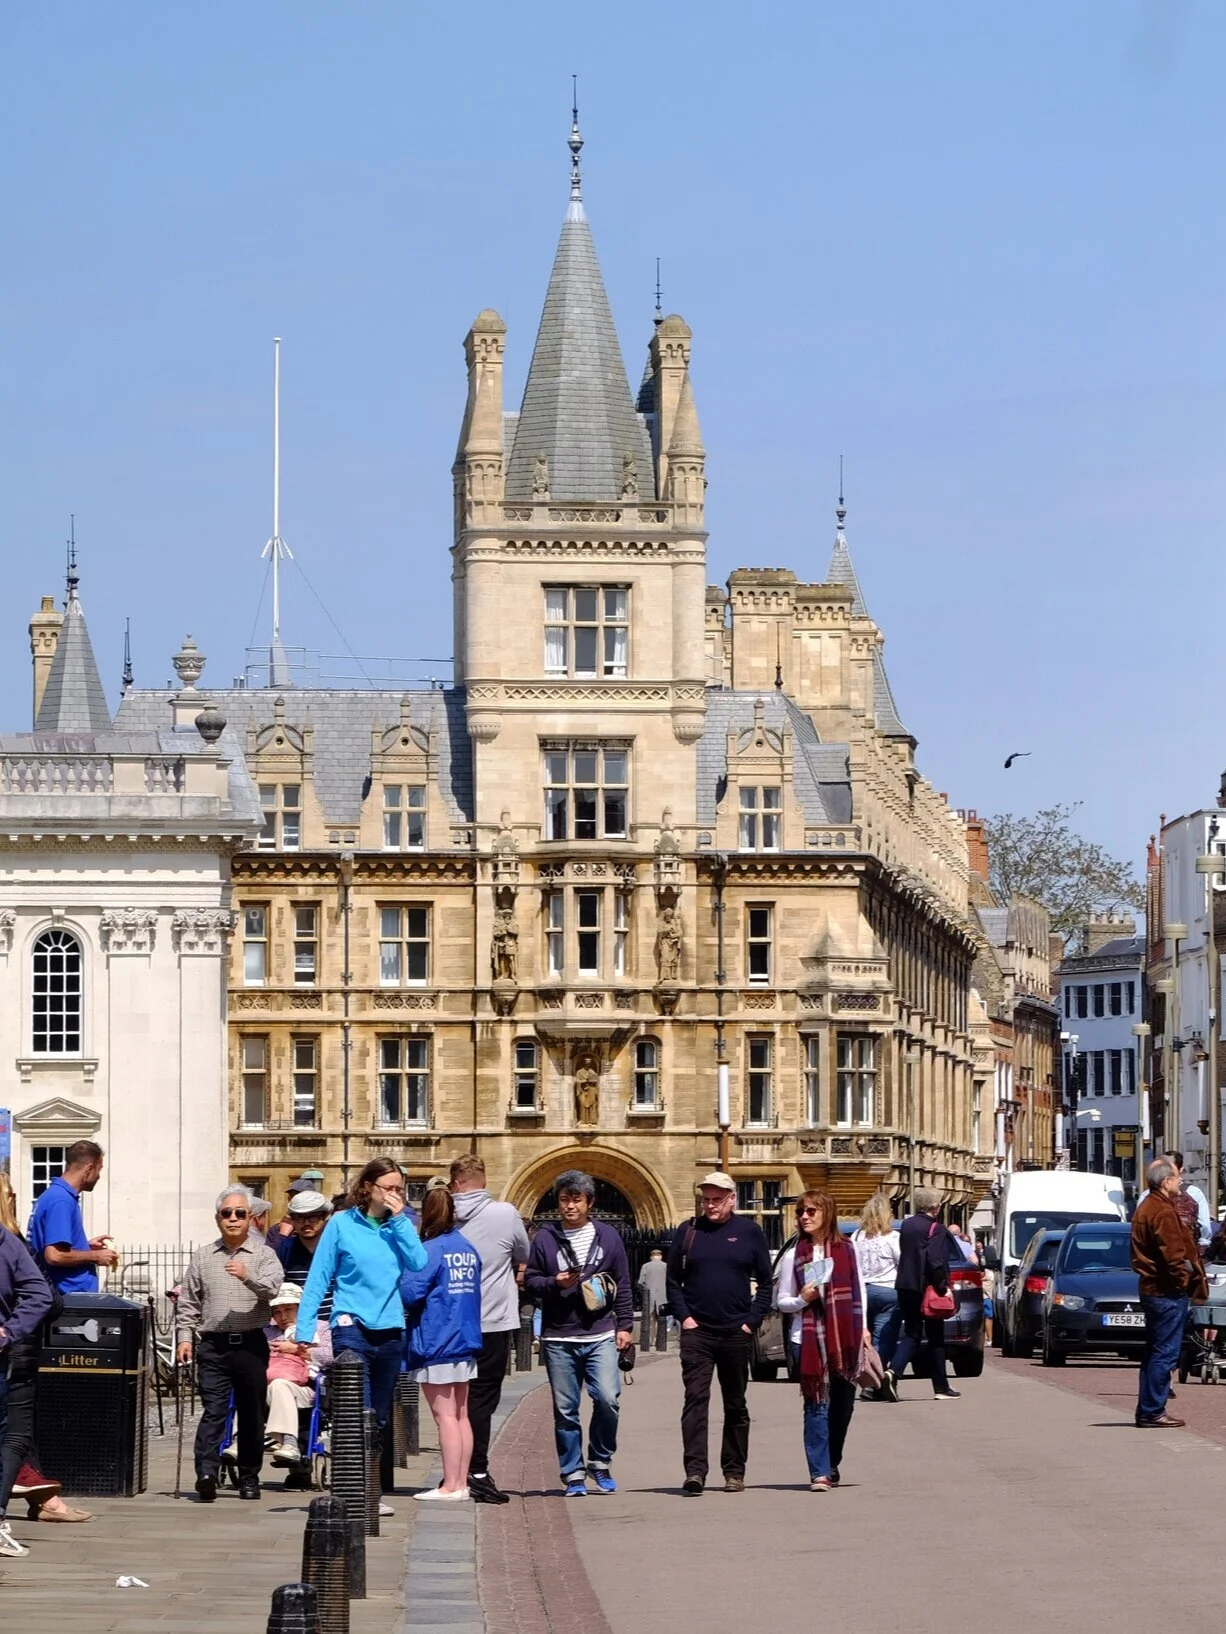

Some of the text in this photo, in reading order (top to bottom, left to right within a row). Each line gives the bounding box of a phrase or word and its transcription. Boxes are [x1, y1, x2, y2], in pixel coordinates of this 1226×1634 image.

[444, 1253, 477, 1267] TOUR
[450, 1268, 474, 1280] INFO
[1109, 1315, 1145, 1324] YE58 ZH
[61, 1354, 98, 1366] Litter
